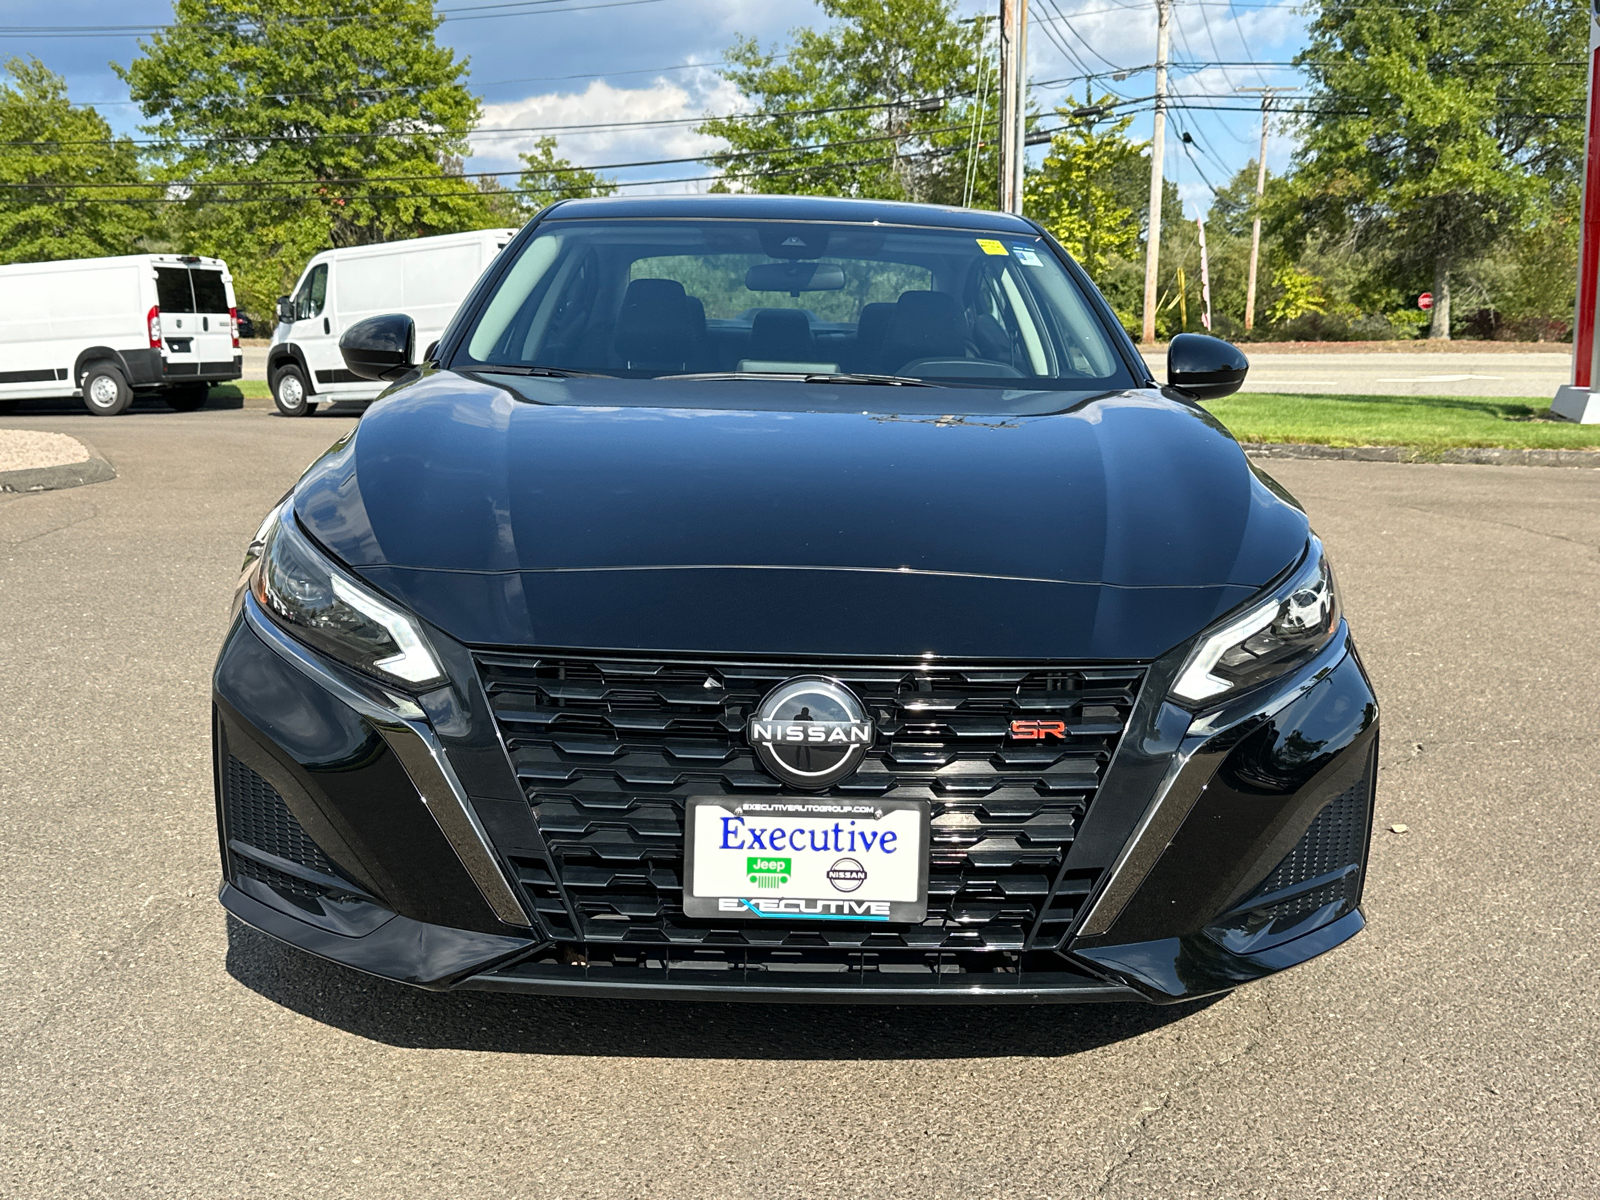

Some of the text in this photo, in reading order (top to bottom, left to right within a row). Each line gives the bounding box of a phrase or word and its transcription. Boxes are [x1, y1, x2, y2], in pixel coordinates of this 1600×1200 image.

[753, 724, 869, 742] NISSAN
[1011, 720, 1066, 739] SR
[743, 803, 874, 813] EXECUTIVEAUTOGROUP.COM
[719, 816, 897, 854] Executive
[752, 858, 786, 872] Jeep
[829, 871, 865, 879] NISSAN
[718, 898, 891, 915] EXECUTIVE
